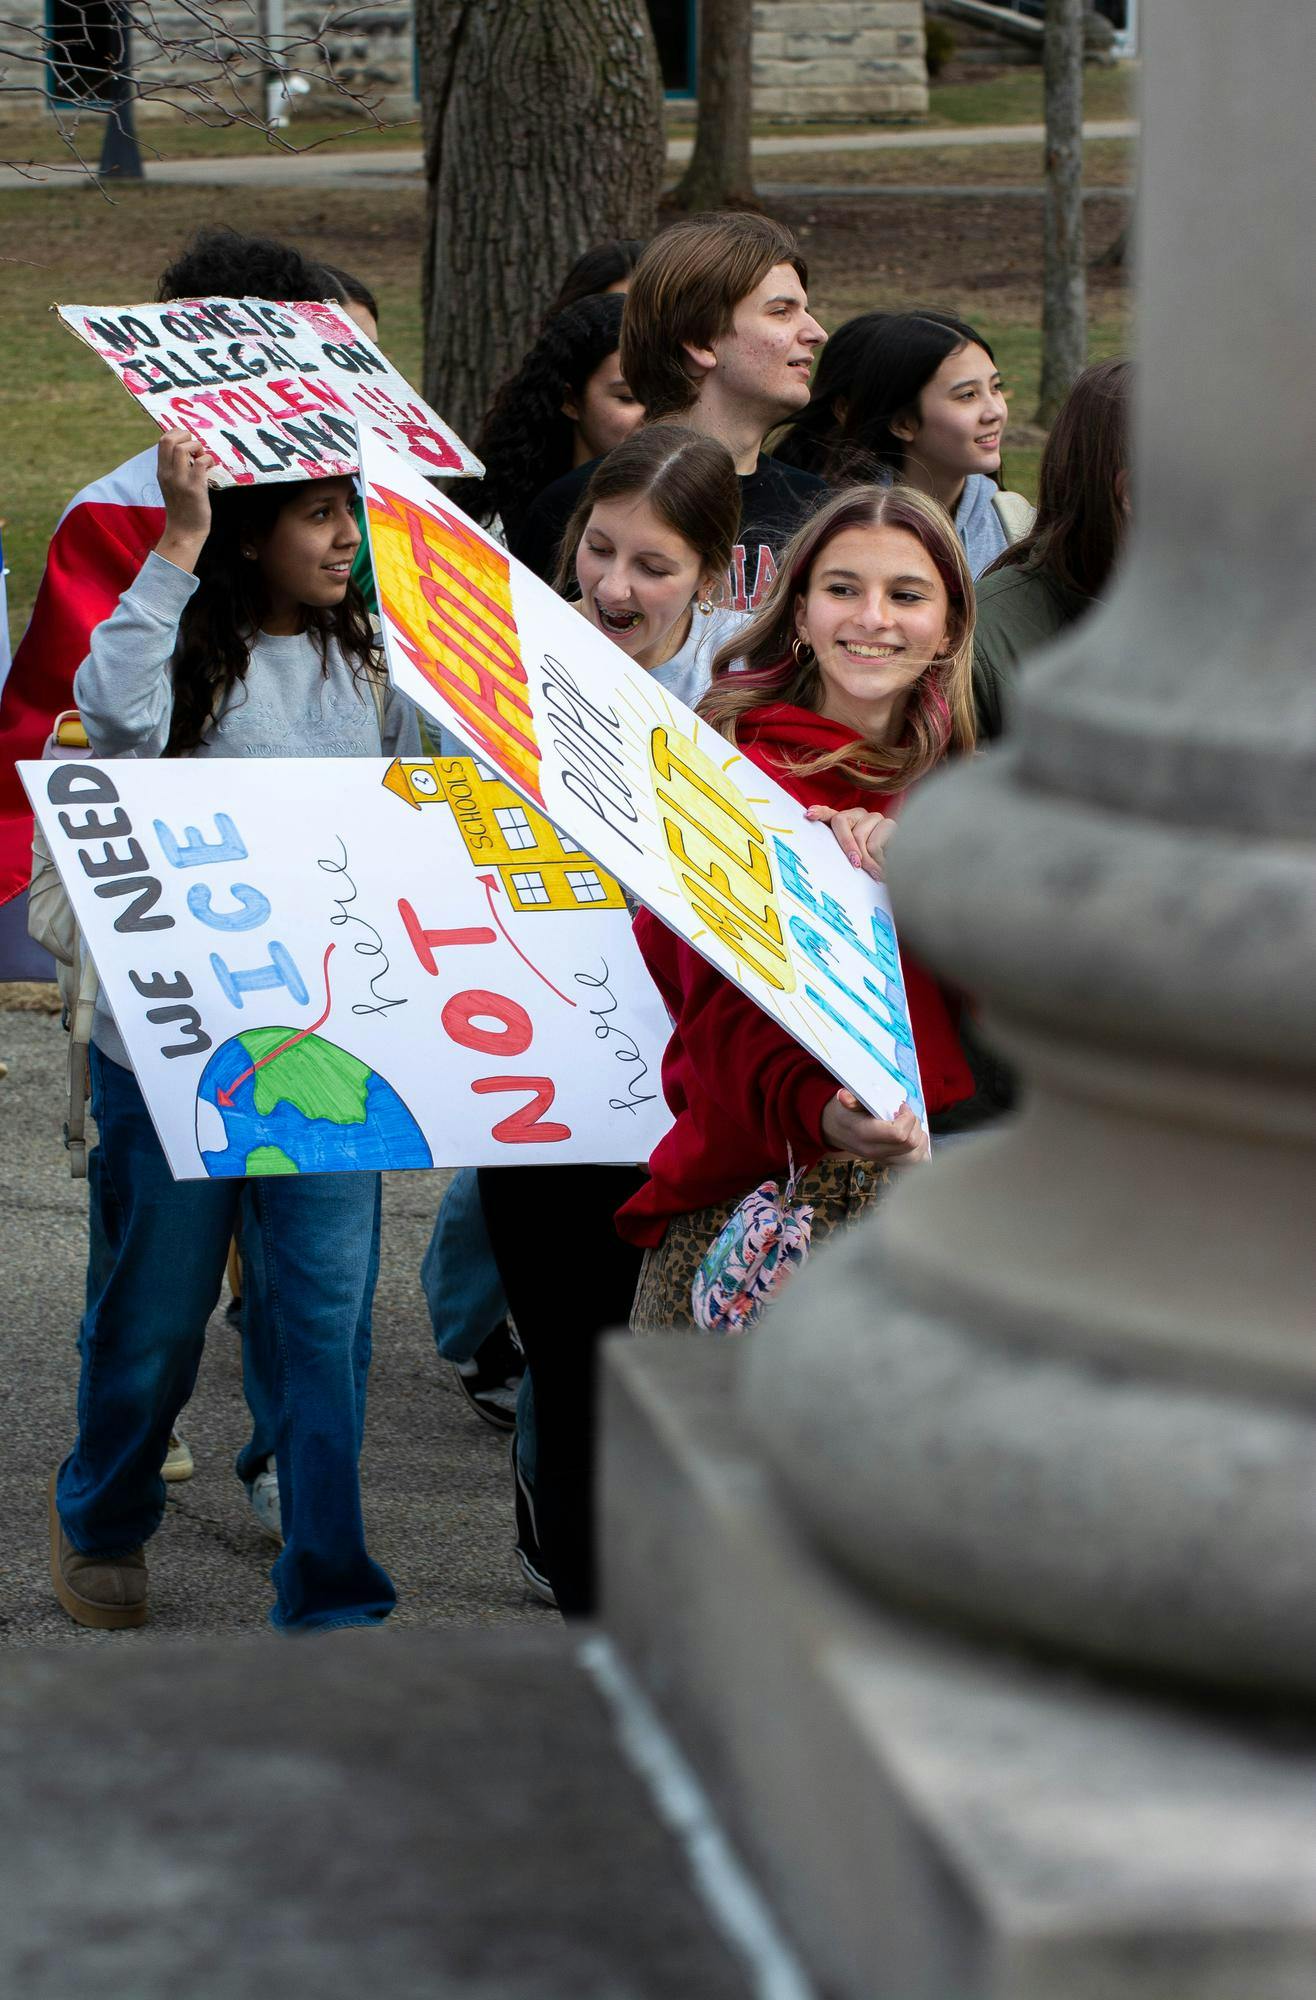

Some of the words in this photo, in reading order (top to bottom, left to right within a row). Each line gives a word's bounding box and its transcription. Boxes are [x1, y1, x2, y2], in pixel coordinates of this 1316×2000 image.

[88, 314, 161, 354] NO
[161, 304, 255, 343] ONE
[239, 303, 296, 339] IS
[119, 341, 319, 394] ILLEGAL
[322, 341, 389, 375] ON
[171, 377, 355, 428] STOLEN
[219, 412, 358, 473] LAND
[405, 507, 542, 761] HOT
[47, 763, 176, 933] NEED
[440, 760, 494, 850] SCHOOLS
[651, 726, 787, 990] MELT
[152, 812, 310, 1010] ICE
[317, 834, 409, 1018] here
[772, 835, 918, 1098] ICE
[128, 969, 213, 1059] WE
[397, 898, 572, 1144] NOT
[573, 955, 658, 1115] here
